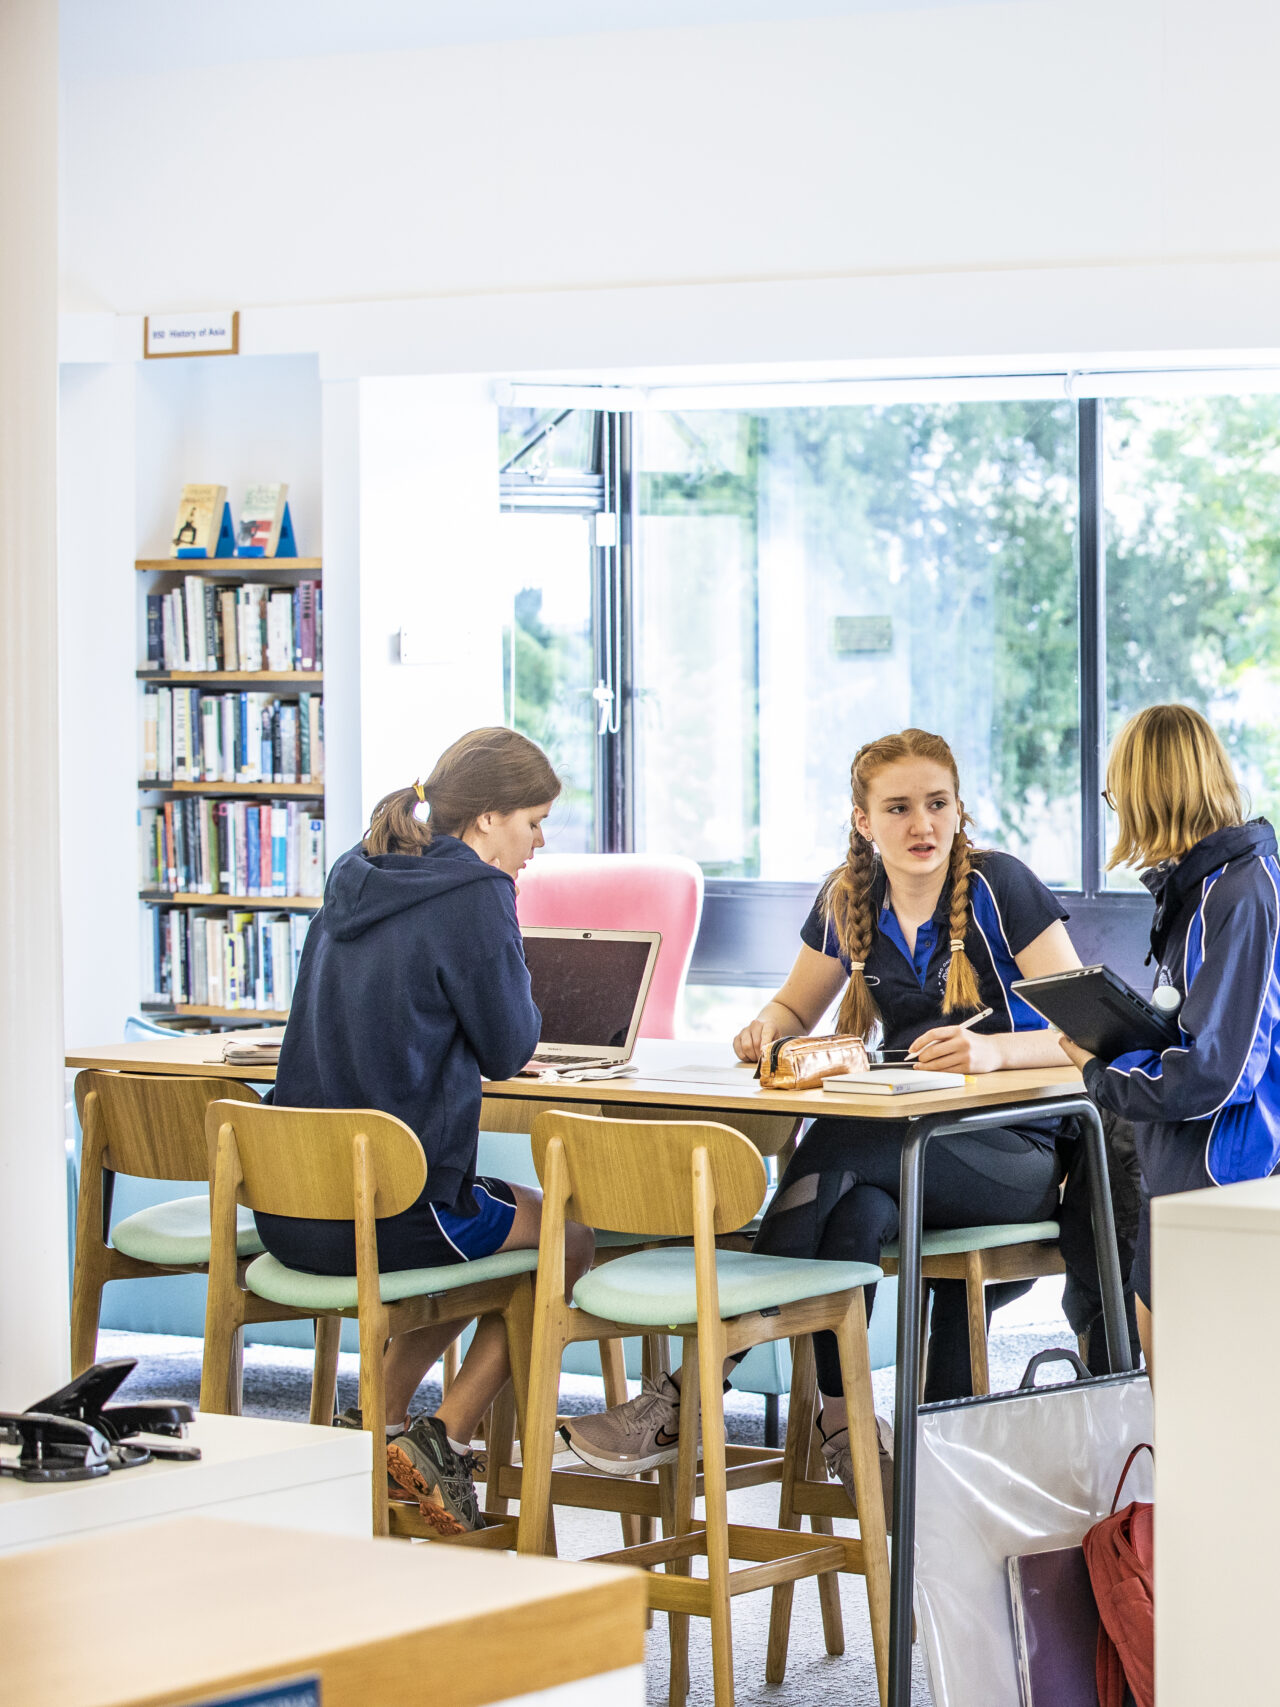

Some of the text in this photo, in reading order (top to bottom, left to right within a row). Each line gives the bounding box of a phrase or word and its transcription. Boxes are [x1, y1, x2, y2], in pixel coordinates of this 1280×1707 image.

[169, 329, 197, 340] History
[199, 327, 207, 337] of
[208, 327, 226, 336] Asia
